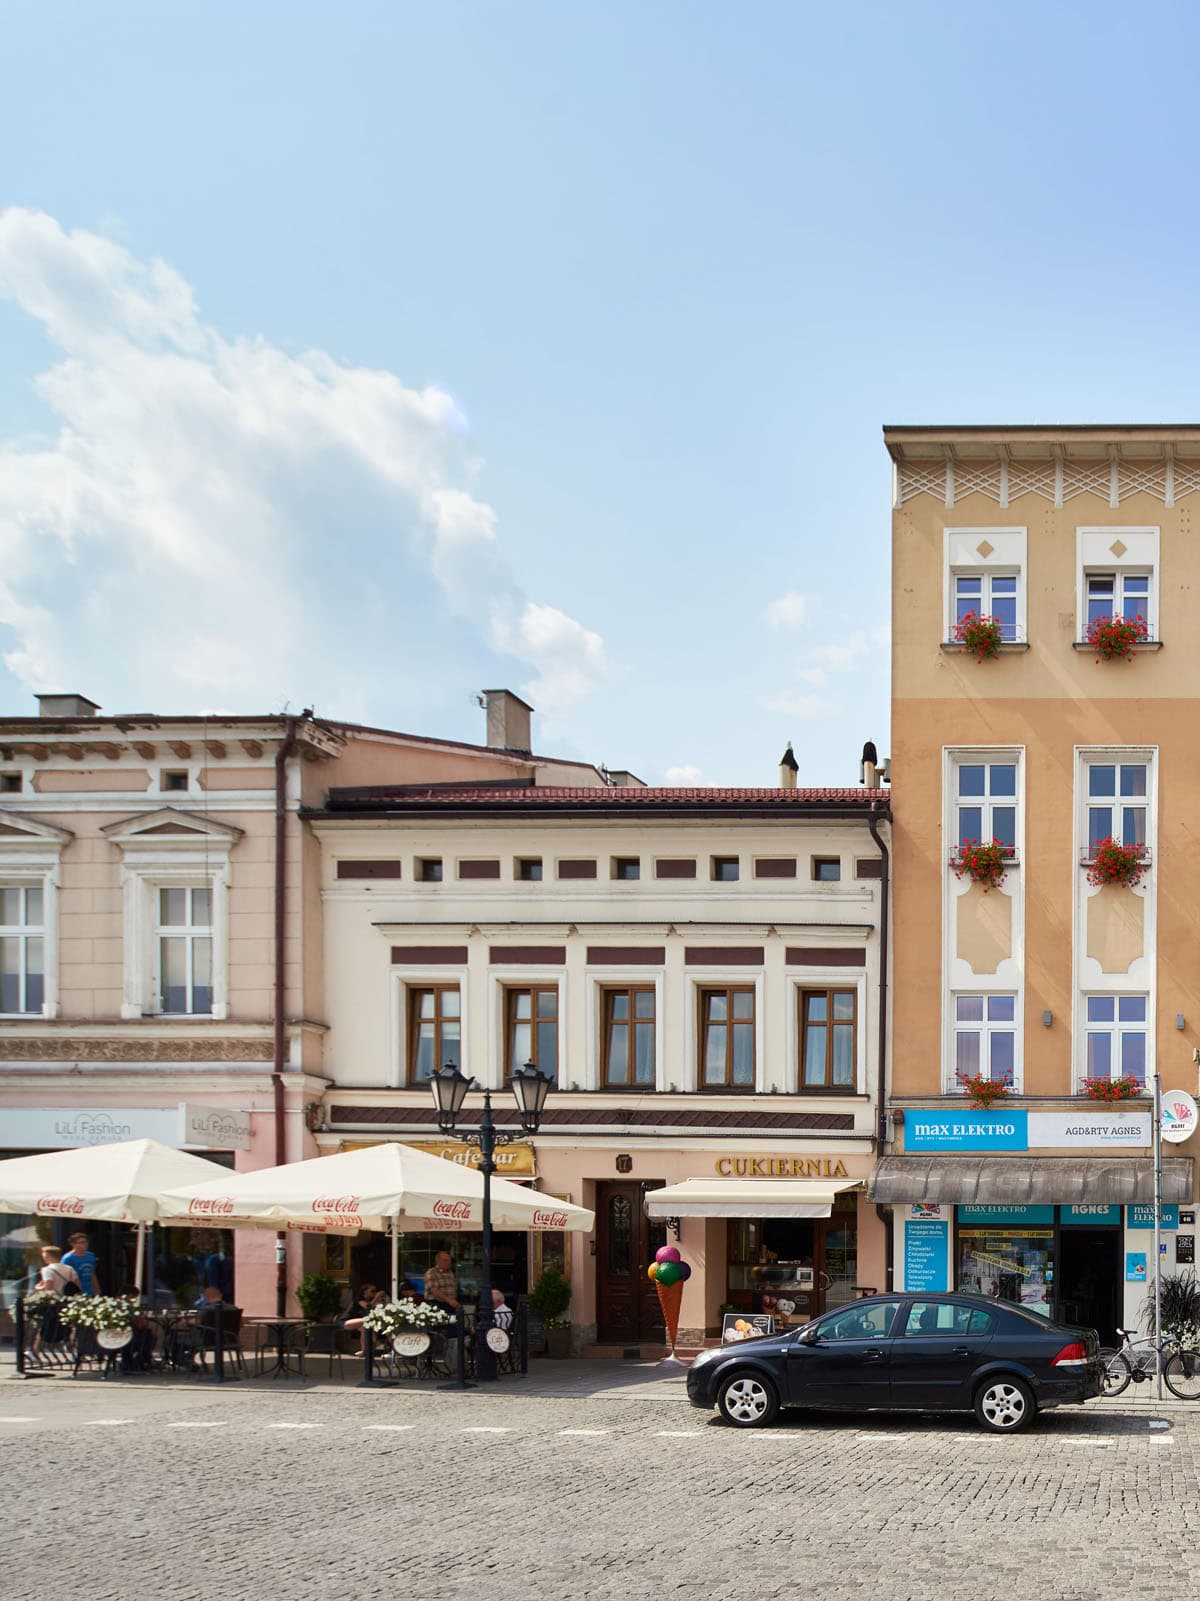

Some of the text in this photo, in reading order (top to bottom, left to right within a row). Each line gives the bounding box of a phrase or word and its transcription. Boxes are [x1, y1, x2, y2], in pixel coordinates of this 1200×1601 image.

[82, 1121, 131, 1135] Fashion
[212, 1120, 249, 1137] Fashion
[914, 1124, 1016, 1136] max ELEKTRO
[1065, 1126, 1142, 1135] AGD&RTV AGNES
[492, 1152, 517, 1165] ar
[617, 1157, 629, 1170] 17
[715, 1158, 849, 1177] CUKIERNIA
[988, 1205, 1027, 1213] ELEKTRO
[1071, 1204, 1110, 1215] AGNES
[1134, 1206, 1156, 1214] max
[1134, 1214, 1172, 1222] ELEKRO
